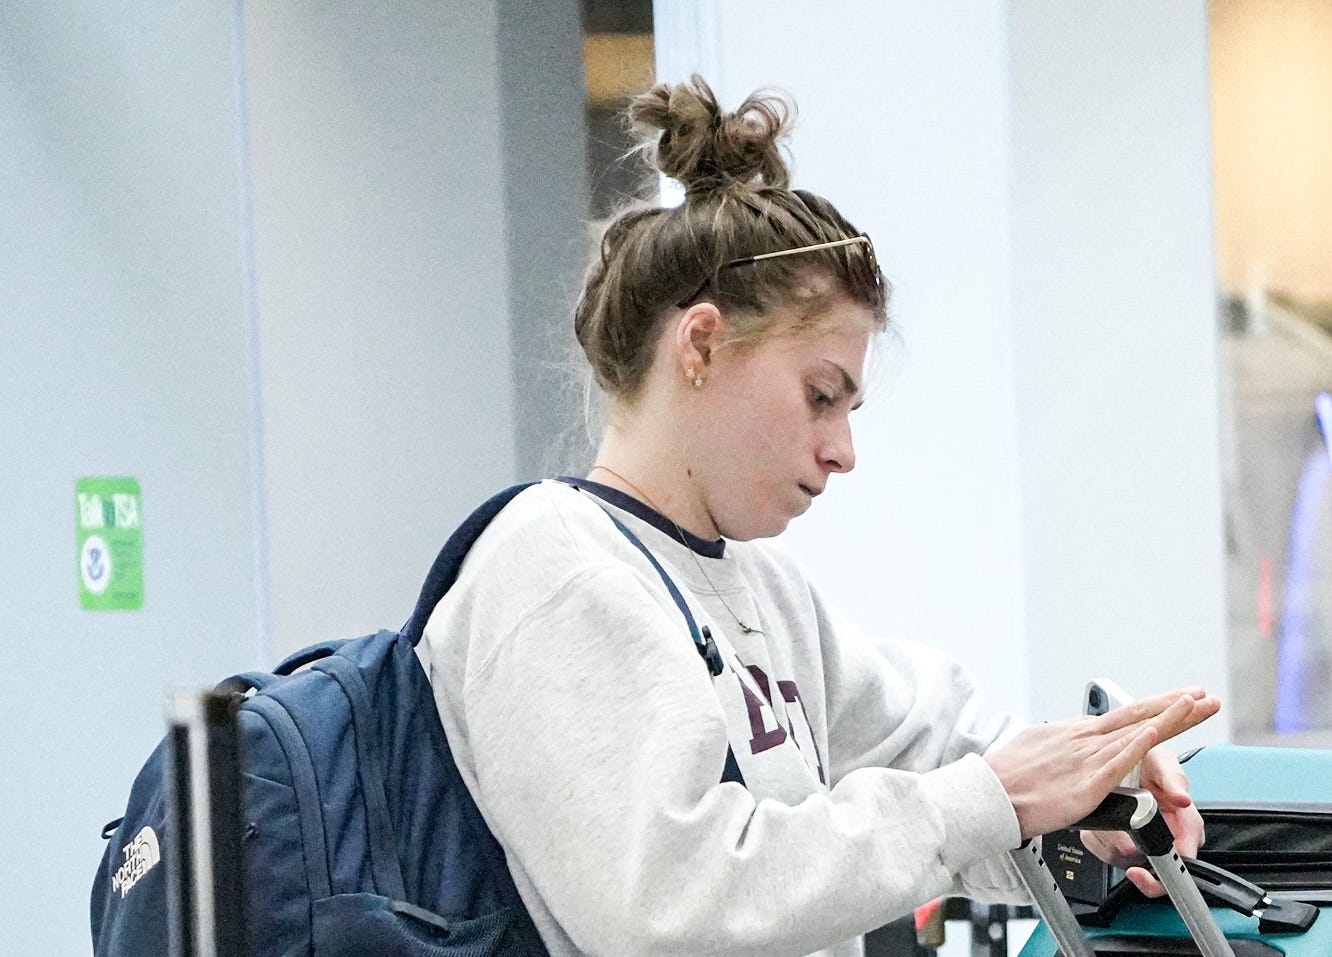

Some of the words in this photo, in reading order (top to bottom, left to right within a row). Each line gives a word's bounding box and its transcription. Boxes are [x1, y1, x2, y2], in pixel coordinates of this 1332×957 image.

[123, 834, 144, 861] THE
[112, 847, 143, 893] NORTH
[121, 859, 147, 899] FACE
